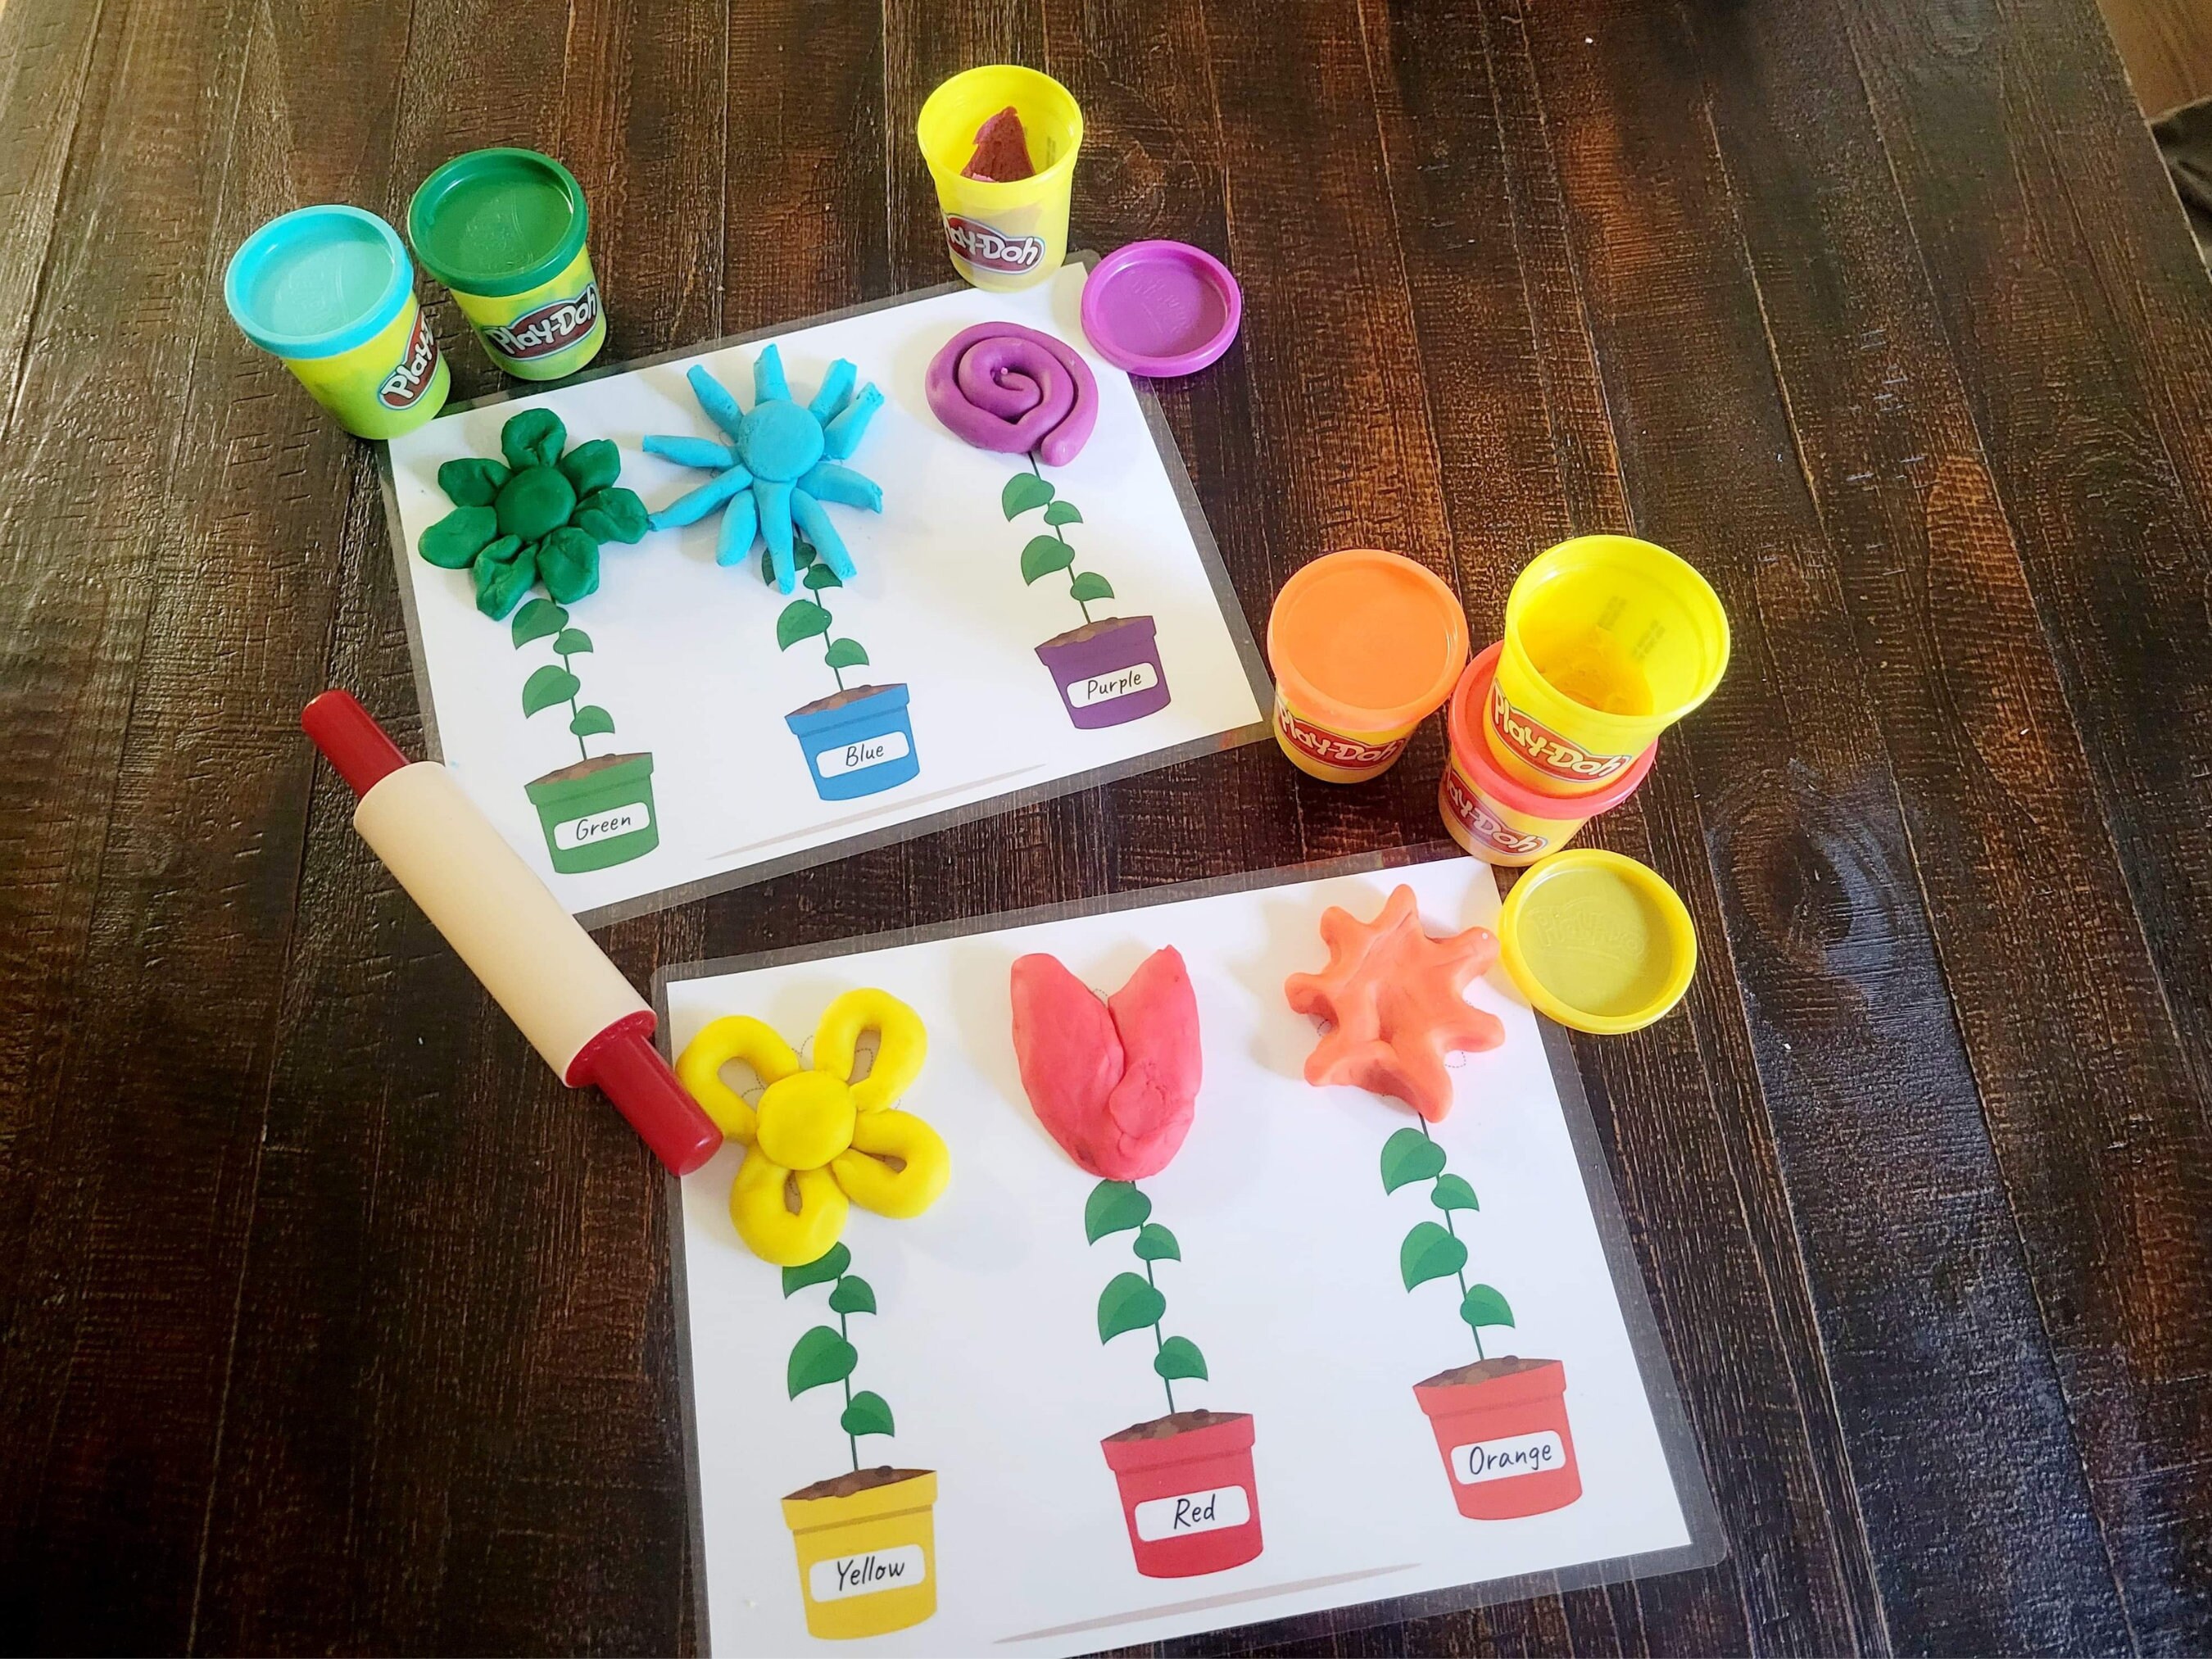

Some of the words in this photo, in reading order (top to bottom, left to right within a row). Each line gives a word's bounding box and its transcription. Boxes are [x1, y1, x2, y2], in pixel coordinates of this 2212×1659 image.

[482, 285, 597, 355] Play-Doh
[1087, 669, 1143, 700] Purple
[1494, 683, 1623, 777] Play-Doh
[845, 742, 885, 767] Blue
[575, 815, 632, 841] Green
[1469, 1444, 1552, 1475] Orange
[1173, 1493, 1217, 1530] Red
[836, 1555, 905, 1592] Yellow
